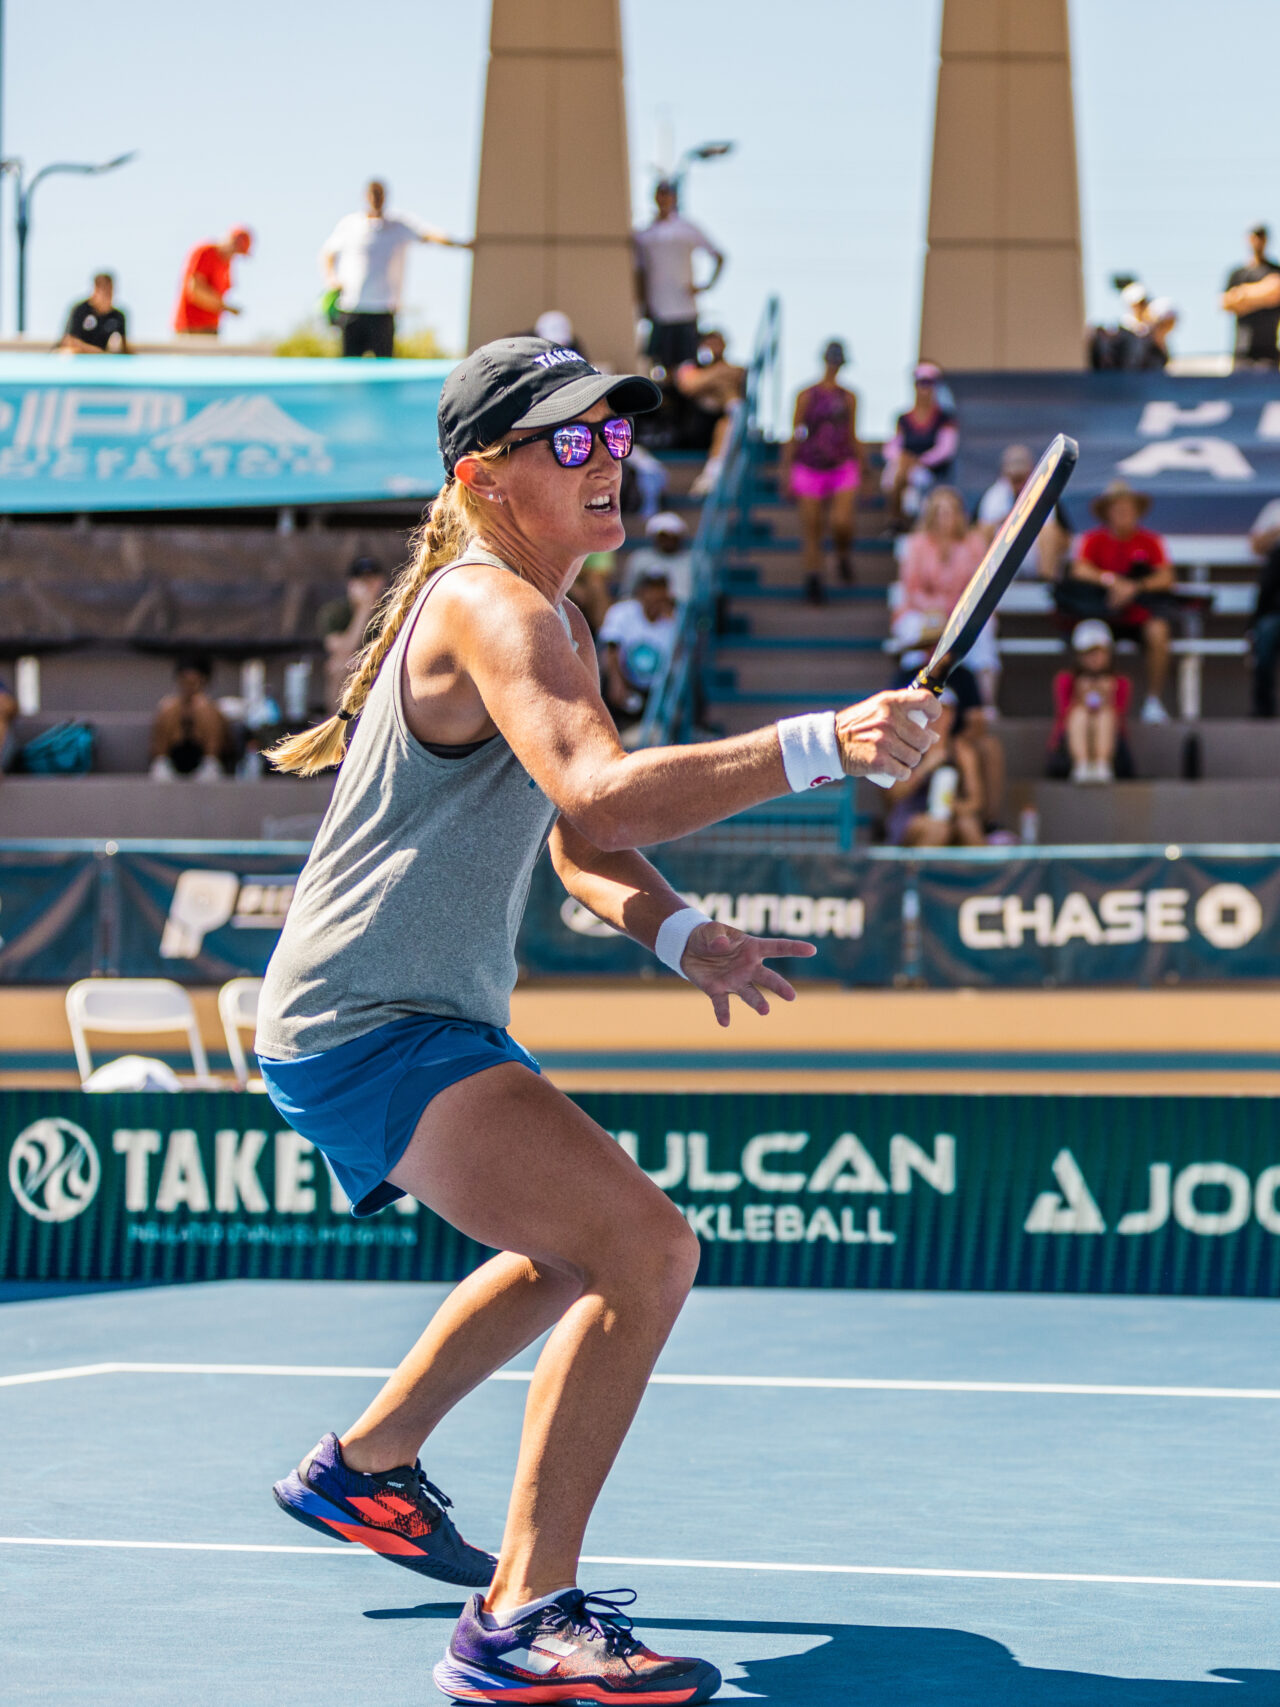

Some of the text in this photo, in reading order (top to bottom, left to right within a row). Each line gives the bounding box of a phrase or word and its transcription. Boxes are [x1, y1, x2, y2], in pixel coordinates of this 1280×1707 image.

[534, 349, 588, 369] TAKE
[679, 892, 865, 940] YUNDAI
[958, 888, 1190, 949] CHASE
[113, 1129, 419, 1215] TAKE
[607, 1131, 955, 1195] ULCAN
[676, 1203, 895, 1244] KLEBALL
